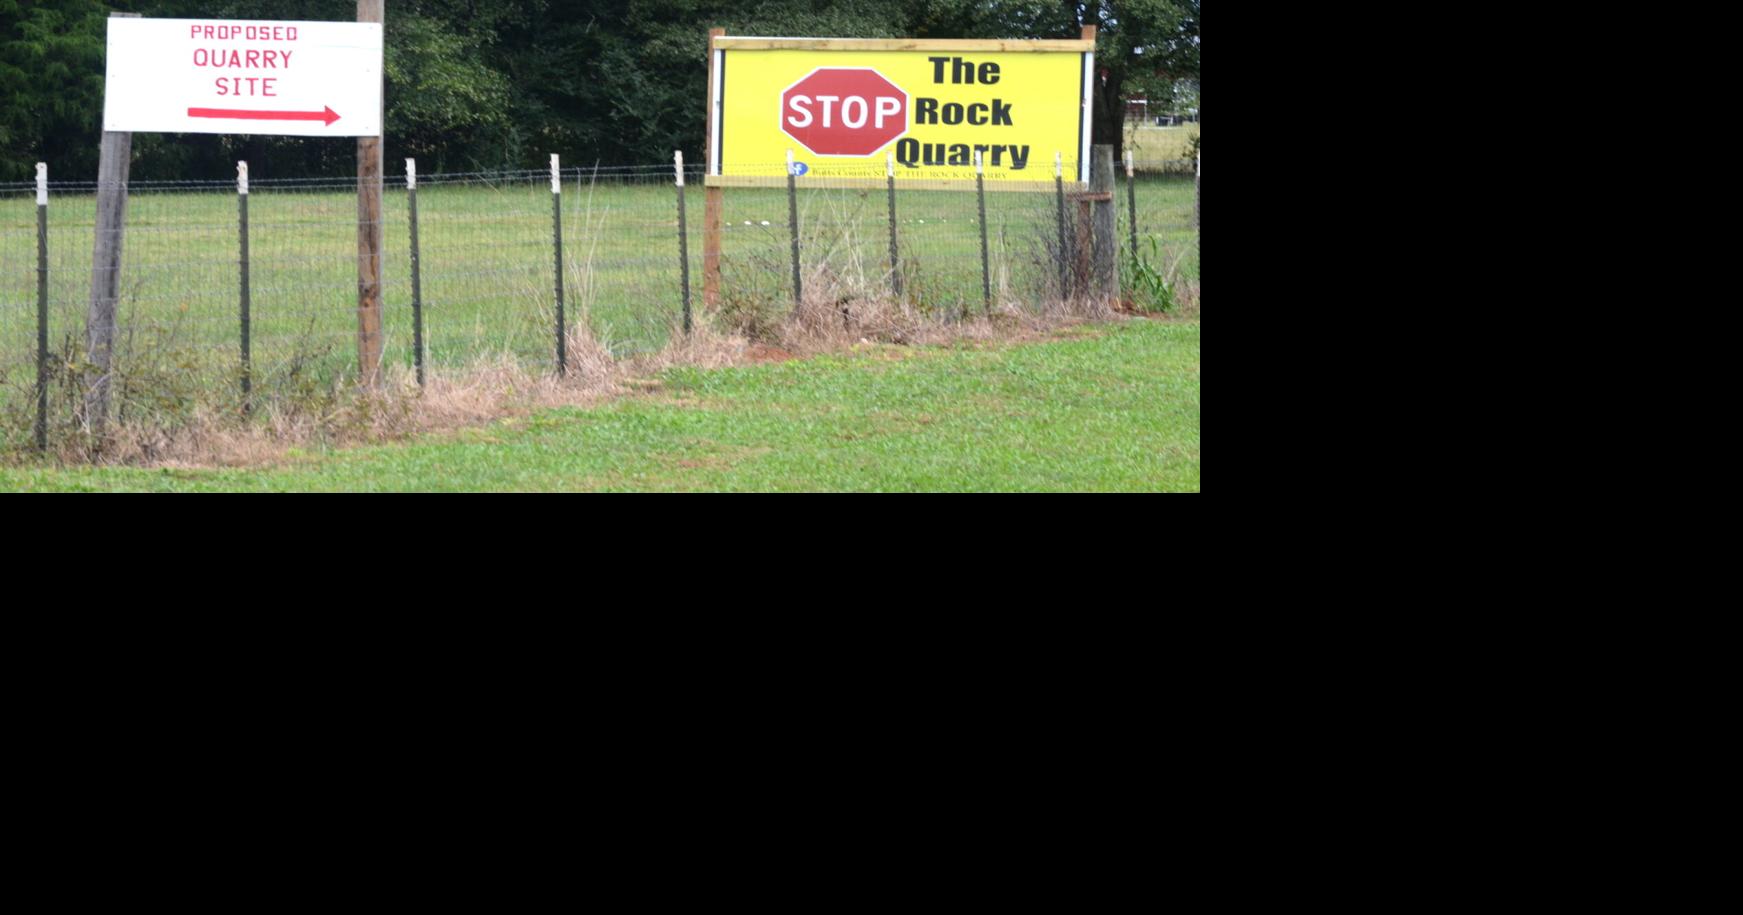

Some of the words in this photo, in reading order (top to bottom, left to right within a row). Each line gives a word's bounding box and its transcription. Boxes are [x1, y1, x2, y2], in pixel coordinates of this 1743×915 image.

[191, 25, 298, 41] PROPOSED
[193, 48, 293, 69] QUARRY
[928, 56, 1001, 85] The
[215, 77, 278, 97] SITE
[787, 95, 901, 129] STOP
[915, 98, 1013, 126] Rock
[896, 137, 1030, 170] Quarry
